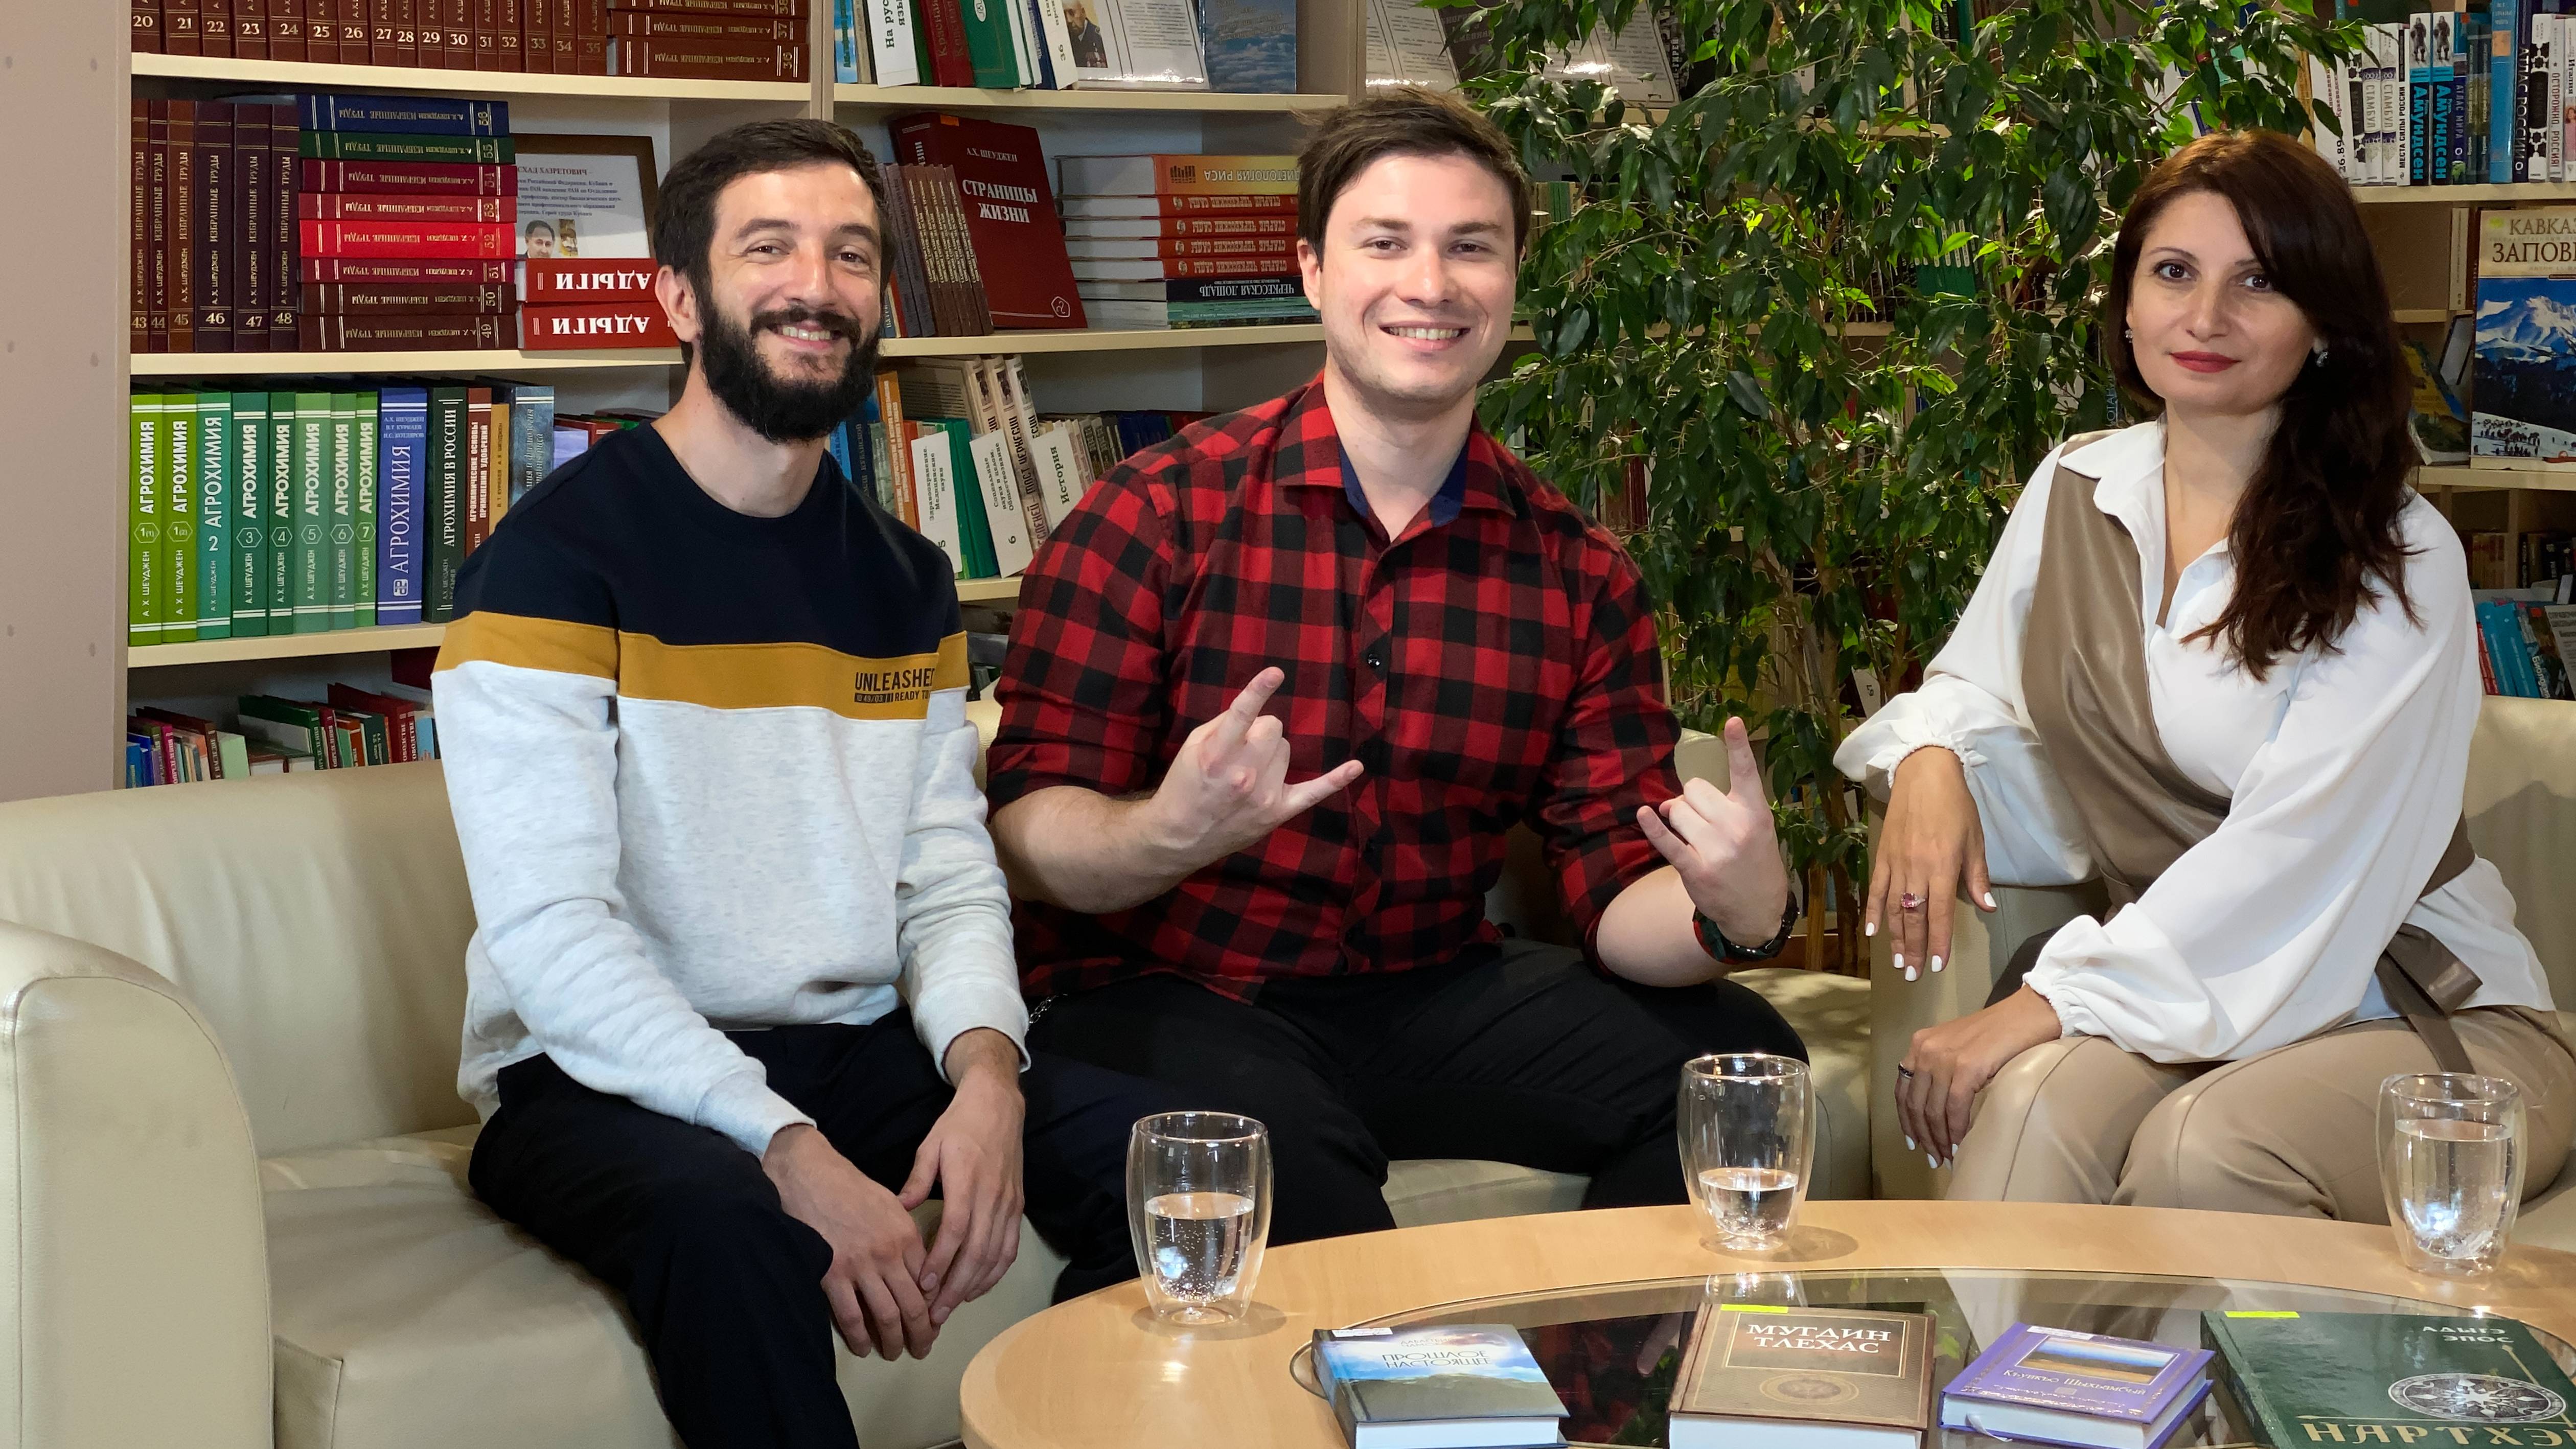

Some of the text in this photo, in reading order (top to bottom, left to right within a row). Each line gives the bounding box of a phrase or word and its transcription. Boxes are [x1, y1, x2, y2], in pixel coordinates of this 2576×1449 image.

[133, 15, 153, 28] 20
[177, 17, 192, 29] 21
[206, 21, 225, 33] 22
[654, 22, 677, 32] ТРУДЫ
[241, 23, 260, 35] 23
[280, 24, 298, 35] 24
[313, 26, 330, 38] 25
[344, 28, 363, 39] 26
[376, 28, 392, 40] 27
[778, 23, 787, 37] 37
[398, 30, 414, 42] 28
[422, 32, 440, 44] 29
[449, 33, 468, 45] 30
[479, 36, 492, 48] 31
[501, 36, 517, 48] 32
[885, 29, 894, 48] На
[531, 38, 546, 49] 33
[557, 39, 572, 51] 34
[586, 42, 601, 54] 35
[655, 53, 678, 62] ТРУДЫ
[783, 52, 792, 69] 36
[2365, 84, 2376, 128] СТАМБУЛ
[2383, 84, 2394, 128] СТАМБУЛ
[2514, 46, 2529, 159] АТЛАС РОССИИ
[339, 108, 365, 119] ТРУДЫ
[2455, 84, 2464, 139] АТЛАС МИРА
[2413, 86, 2428, 179] Амундсен
[2435, 84, 2452, 178] Амундсен
[345, 142, 371, 152] ТРУДЫ
[483, 144, 493, 159] 55
[980, 149, 1018, 163] ШЕУДЖЕН
[135, 152, 144, 180] ТРУДЫ
[154, 153, 164, 181] ТРУДЫ
[179, 152, 188, 181] ТРУДЫ
[210, 155, 219, 183] ТРУДЫ
[249, 156, 258, 185] ТРУДЫ
[281, 157, 290, 185] ТРУДЫ
[349, 172, 374, 182] ТРУДЫ
[1204, 170, 1233, 181] РИСА
[962, 179, 1038, 204] СТРАНИЦЫ
[346, 202, 372, 212] ТРУДЫ
[1188, 197, 1209, 209] САДЫ
[1255, 197, 1280, 208] СТАРЫЕ
[135, 186, 144, 241] ИЗБРАННЫЕ
[154, 187, 163, 241] ИЗБРАННЫЕ
[249, 189, 258, 242] ИЗБРАННЫЕ
[281, 190, 289, 242] ИЗБРАННЫЕ
[484, 203, 493, 218] 53
[978, 203, 1030, 223] ЖИЗНИ
[1192, 220, 1285, 233] СТАРЫЕ САДЫ
[344, 233, 370, 242] ТРУДЫ
[485, 234, 494, 249] 52
[1191, 241, 1211, 254] САДЫ
[1259, 240, 1285, 251] СТАРЫЕ
[343, 265, 369, 275] ТРУДЫ
[490, 266, 498, 279] 51
[1194, 260, 1287, 273] СТАРЫЕ САДЫ
[556, 271, 652, 291] АДЫГИ
[1200, 283, 1294, 296] ЧЕРКЕССКАЯ ЛОШАДЬ
[352, 294, 378, 304] ТРУДЫ
[486, 291, 495, 307] 50
[132, 316, 147, 328] 43
[151, 316, 165, 328] 44
[174, 314, 188, 325] 45
[205, 313, 225, 324] 46
[245, 316, 263, 327] 47
[275, 312, 292, 324] 48
[481, 324, 492, 338] 49
[553, 316, 650, 335] АДЫГИ
[346, 329, 372, 338] ТРУДЫ
[444, 409, 456, 458] РОССИИ
[140, 422, 155, 514] АГРОХИМИЯ
[173, 421, 187, 512] АГРОХИМИЯ
[204, 417, 222, 527] АГРОХИМИЯ
[243, 424, 257, 518] АГРОХИМИЯ
[276, 425, 289, 518] АГРОХИМИЯ
[306, 423, 319, 516] АГРОХИМИЯ
[335, 424, 349, 515] АГРОХИМИЯ
[360, 422, 373, 514] АГРОХИМИЯ
[470, 422, 478, 521] АГРОХИМИЧЕСКИЕ ОСНОВЫ
[479, 425, 489, 518] ПРИМЕНЕНИЯ УДОБРЕНИЙ
[930, 453, 940, 509] Медицинские
[994, 443, 1015, 511] Обществознание
[1049, 446, 1070, 504] История
[983, 457, 999, 507] Социальные
[389, 445, 410, 573] АГРОХИМИЯ
[444, 473, 456, 546] АГРОХИМИЯ
[246, 532, 254, 543] 3
[278, 532, 286, 542] 4
[307, 529, 316, 540] 5
[339, 530, 347, 539] 6
[362, 526, 370, 537] 7
[208, 536, 218, 551] 2
[1008, 536, 1016, 544] 6
[175, 550, 183, 594] ШЕУДЖЕН
[277, 553, 285, 587] ШЕУДЖЕН
[894, 691, 919, 701] READY
[1747, 1324, 1891, 1342] МУГДИН
[2422, 1326, 2505, 1335] АДЫГЭ
[1754, 1337, 1880, 1354] ТЛЕХАС
[2442, 1335, 2514, 1343] ЭПОС
[1382, 1350, 1488, 1361] ПРОШЛОЕ
[1386, 1358, 1492, 1368] НАСТОЯЩЕЕ
